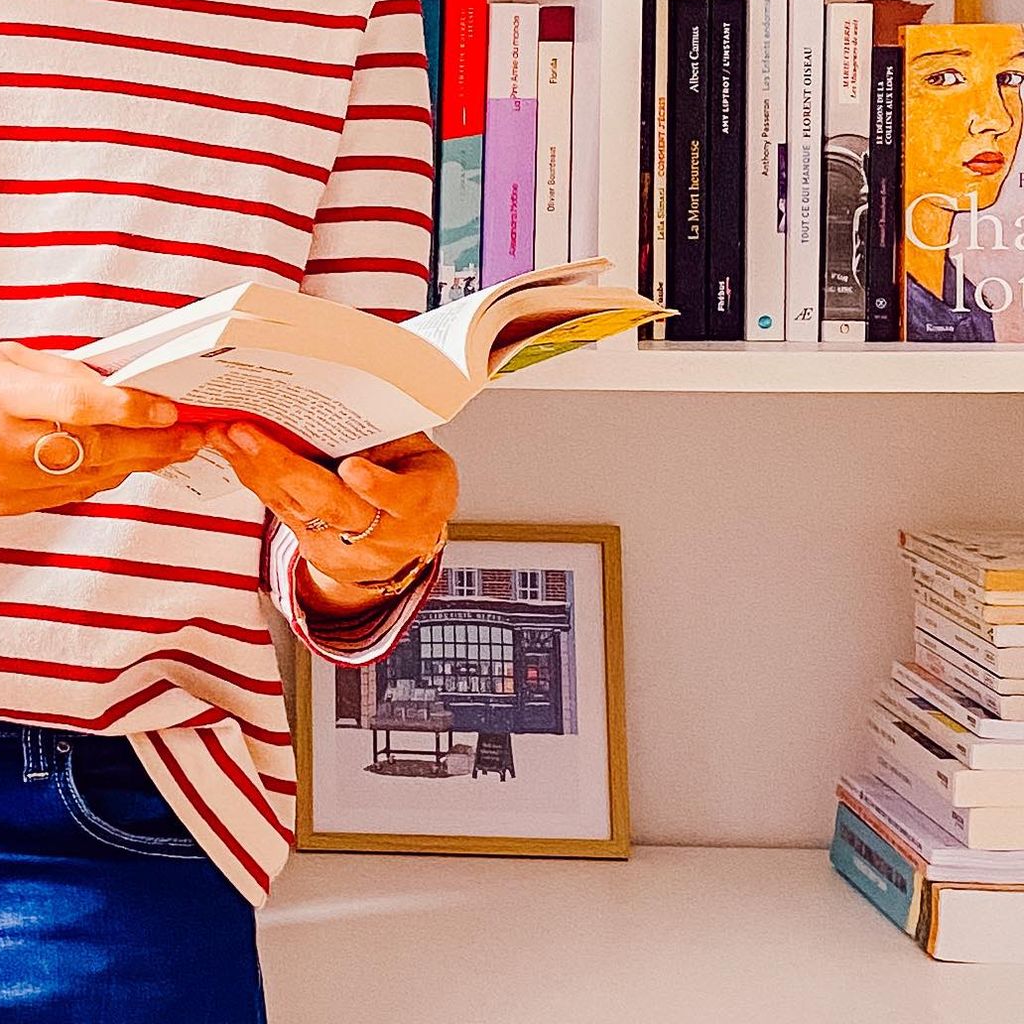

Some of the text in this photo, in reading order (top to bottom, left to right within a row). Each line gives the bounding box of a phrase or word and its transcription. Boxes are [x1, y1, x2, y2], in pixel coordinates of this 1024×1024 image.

[722, 23, 730, 66] L'INSTANT
[762, 41, 770, 73] Enfants
[690, 26, 699, 92] Albert Camus
[803, 47, 812, 138] FLORENT OISEAU
[877, 82, 884, 91] LA
[877, 93, 883, 103] DE
[514, 101, 521, 111] La
[876, 135, 883, 144] LE
[762, 141, 771, 176] Anthony
[802, 145, 811, 184] MANQUE
[547, 189, 555, 212] Olivier
[688, 140, 699, 240] La Mort heureuse
[802, 187, 810, 204] QUI
[802, 207, 809, 218] CE
